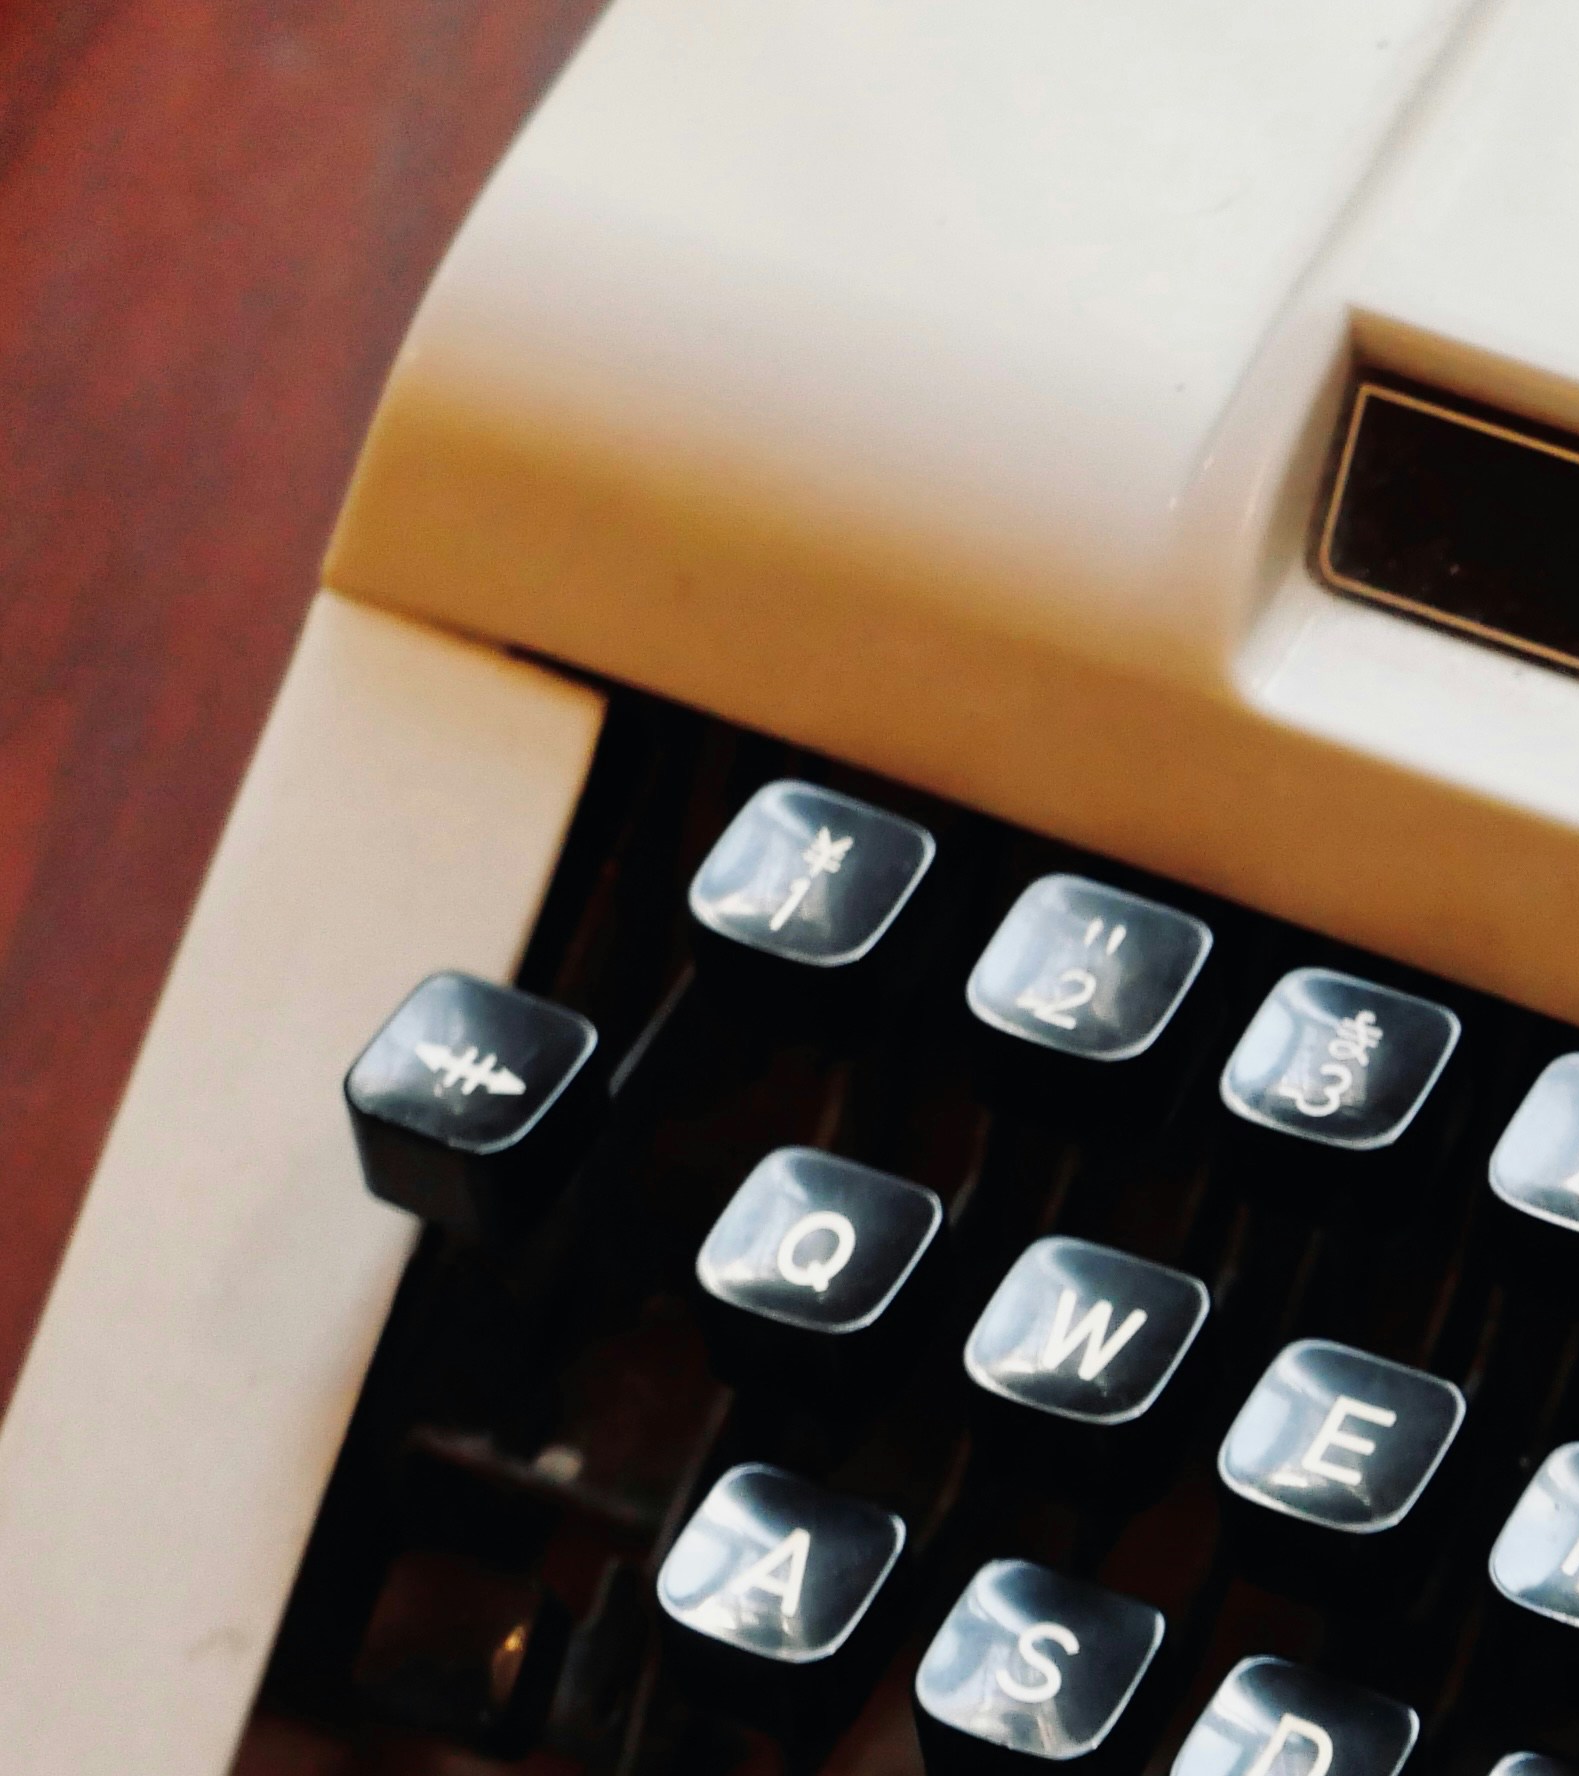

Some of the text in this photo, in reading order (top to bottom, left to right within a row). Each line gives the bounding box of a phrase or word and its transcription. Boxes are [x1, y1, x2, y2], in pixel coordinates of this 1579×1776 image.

[769, 878, 810, 931] 1
[1033, 968, 1096, 1030] 2
[1295, 1064, 1352, 1117] 3
[777, 1211, 855, 1293] Q
[1040, 1288, 1147, 1381] W
[1302, 1395, 1397, 1485] E
[721, 1528, 810, 1617] A
[996, 1622, 1080, 1703] S
